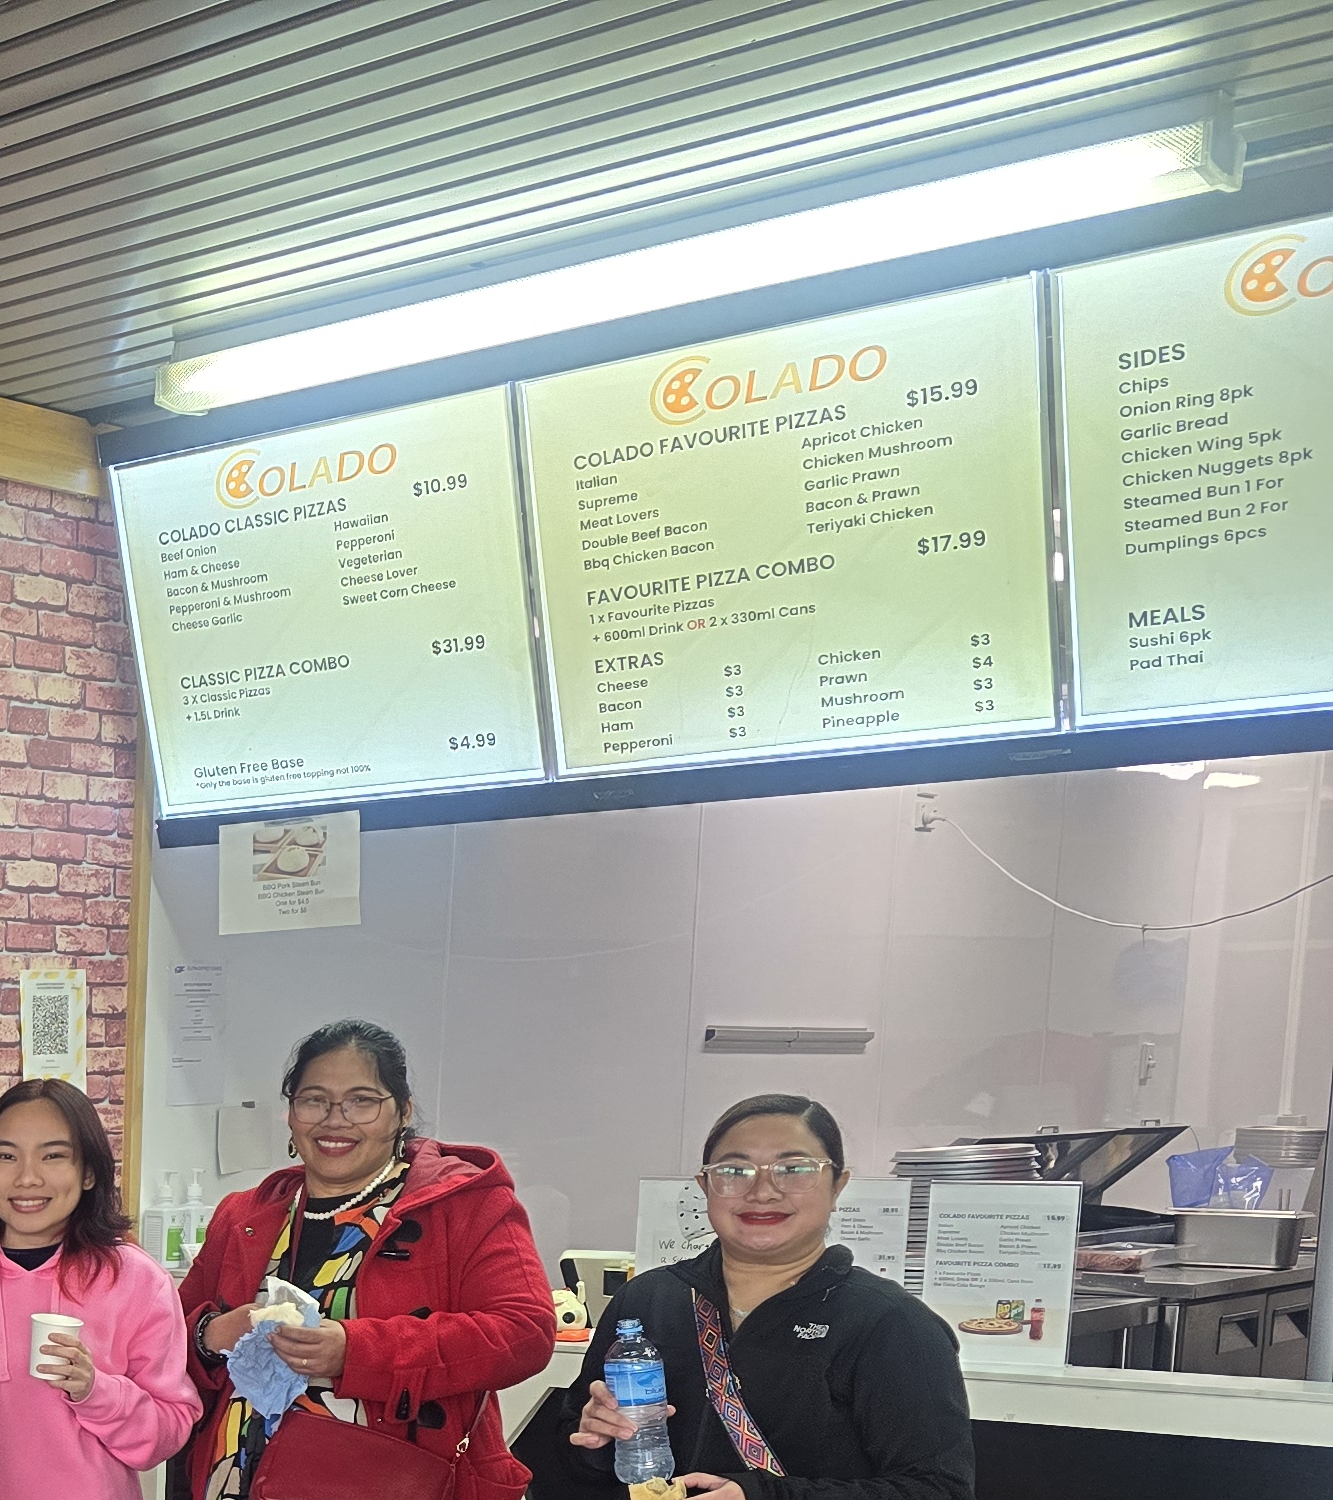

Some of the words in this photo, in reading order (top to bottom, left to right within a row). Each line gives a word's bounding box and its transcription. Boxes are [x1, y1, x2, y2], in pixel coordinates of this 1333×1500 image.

[1118, 342, 1186, 370] SIDES
[650, 344, 888, 425] COLADO
[906, 378, 978, 408] $15.99
[1118, 377, 1169, 395] Chips
[1119, 400, 1171, 418] Onion
[1175, 393, 1215, 409] Ring
[1219, 384, 1254, 404] 8pk
[573, 441, 654, 471] COLADO
[659, 418, 770, 455] FAVOURITE
[775, 404, 847, 433] PIZZAS
[801, 428, 857, 451] Apricot
[860, 418, 923, 438] Chicken
[1120, 422, 1172, 441] Garlic
[1176, 411, 1229, 433] Bread
[802, 451, 864, 470] Chicken
[868, 436, 953, 460] Mushroom
[1121, 444, 1193, 464] Chicken
[1196, 436, 1243, 453] Wing
[1248, 428, 1282, 448] 5pk
[216, 443, 398, 509] COLADO
[1122, 467, 1193, 487] Chicken
[1197, 454, 1274, 477] Nuggets
[1278, 447, 1313, 467] 8pk
[412, 473, 468, 498] $10.99
[575, 475, 618, 491] Italian
[804, 473, 849, 492] Garlic
[852, 467, 900, 484] Prawn
[578, 492, 638, 512] Supreme
[805, 497, 853, 514] Bacon
[856, 492, 869, 505] &
[872, 485, 921, 503] Prawn
[1123, 486, 1202, 510] Steamed
[1206, 484, 1241, 499] Bun
[1244, 479, 1251, 493] 1
[1256, 477, 1285, 492] For
[158, 522, 221, 546] COLADO
[224, 508, 290, 534] CLASSIC
[293, 497, 347, 522] PIZZAS
[333, 513, 389, 532] Hawaiian
[579, 515, 614, 531] Meat
[616, 508, 660, 525] Lovers
[806, 512, 866, 534] Teriyaki
[869, 505, 934, 524] Chicken
[1124, 509, 1203, 533] Steamed
[1207, 507, 1241, 522] Bun
[1245, 502, 1256, 516] 2
[1260, 500, 1289, 514] For
[336, 529, 395, 552] Pepperoni
[581, 533, 629, 551] Double
[631, 525, 661, 543] Beef
[664, 521, 708, 537] Bacon
[917, 529, 986, 556] $17.99
[1125, 533, 1219, 556] Dumplings
[1224, 527, 1267, 545] 6pcs
[160, 548, 184, 563] Beef
[185, 544, 217, 558] Onion
[338, 549, 403, 570] Vegeterian
[583, 558, 610, 571] Bbq
[612, 548, 668, 566] Chicken
[670, 541, 715, 556] Bacon
[163, 568, 189, 581] Ham
[190, 565, 200, 576] &
[200, 559, 240, 574] Cheese
[340, 572, 384, 587] Cheese
[386, 566, 418, 581] Lover
[587, 575, 691, 606] FAVOURITE
[696, 567, 751, 590] PIZZA
[755, 554, 835, 580] COMBO
[166, 585, 199, 598] Bacon
[200, 581, 210, 592] &
[210, 573, 269, 591] Mushroom
[342, 591, 378, 606] Sweet
[379, 587, 409, 600] Corn
[410, 580, 457, 595] Cheese
[169, 596, 221, 617] Pepperoni
[222, 596, 232, 607] &
[233, 587, 292, 606] Mushroom
[589, 614, 595, 625] 1
[597, 614, 606, 624] x
[607, 603, 671, 623] Favourite
[673, 598, 715, 613] Pizzas
[171, 619, 210, 632] Cheese
[211, 612, 243, 626] Garlic
[604, 626, 646, 642] 600ml
[648, 621, 685, 636] Drink
[686, 618, 706, 631] OR
[709, 616, 718, 628] 2
[720, 616, 729, 627] x
[731, 607, 775, 625] 330ml
[778, 604, 816, 618] Cans
[1128, 604, 1206, 629] MEALS
[431, 634, 485, 656] $31.99
[970, 633, 991, 648] $3
[1129, 631, 1175, 649] Sushi
[1179, 628, 1212, 646] 6pk
[594, 651, 664, 674] EXTRAS
[817, 649, 881, 666] Chicken
[972, 655, 994, 670] $4
[1129, 655, 1163, 671] Pad
[1165, 650, 1204, 667] Thai
[180, 670, 241, 690] CLASSIC
[244, 663, 287, 682] PIZZA
[289, 654, 350, 675] COMBO
[723, 664, 742, 678] $3
[819, 672, 868, 687] Prawn
[596, 678, 649, 693] Cheese
[725, 685, 744, 698] $3
[972, 677, 994, 691] $3
[182, 695, 190, 706] 3
[199, 689, 238, 704] Classic
[238, 687, 271, 699] Pizzas
[598, 700, 642, 714] Bacon
[821, 690, 905, 708] Mushroom
[974, 699, 995, 713] $3
[193, 710, 213, 722] 1.5L
[213, 706, 241, 720] Drink
[727, 705, 745, 719] $3
[822, 709, 900, 729] Pineapple
[601, 721, 634, 734] Ham
[729, 726, 747, 739] $3
[448, 732, 496, 751] $4.99
[603, 733, 673, 755] Pepperoni
[193, 765, 238, 779] Gluten
[239, 762, 268, 774] Free
[270, 758, 304, 770] Base
